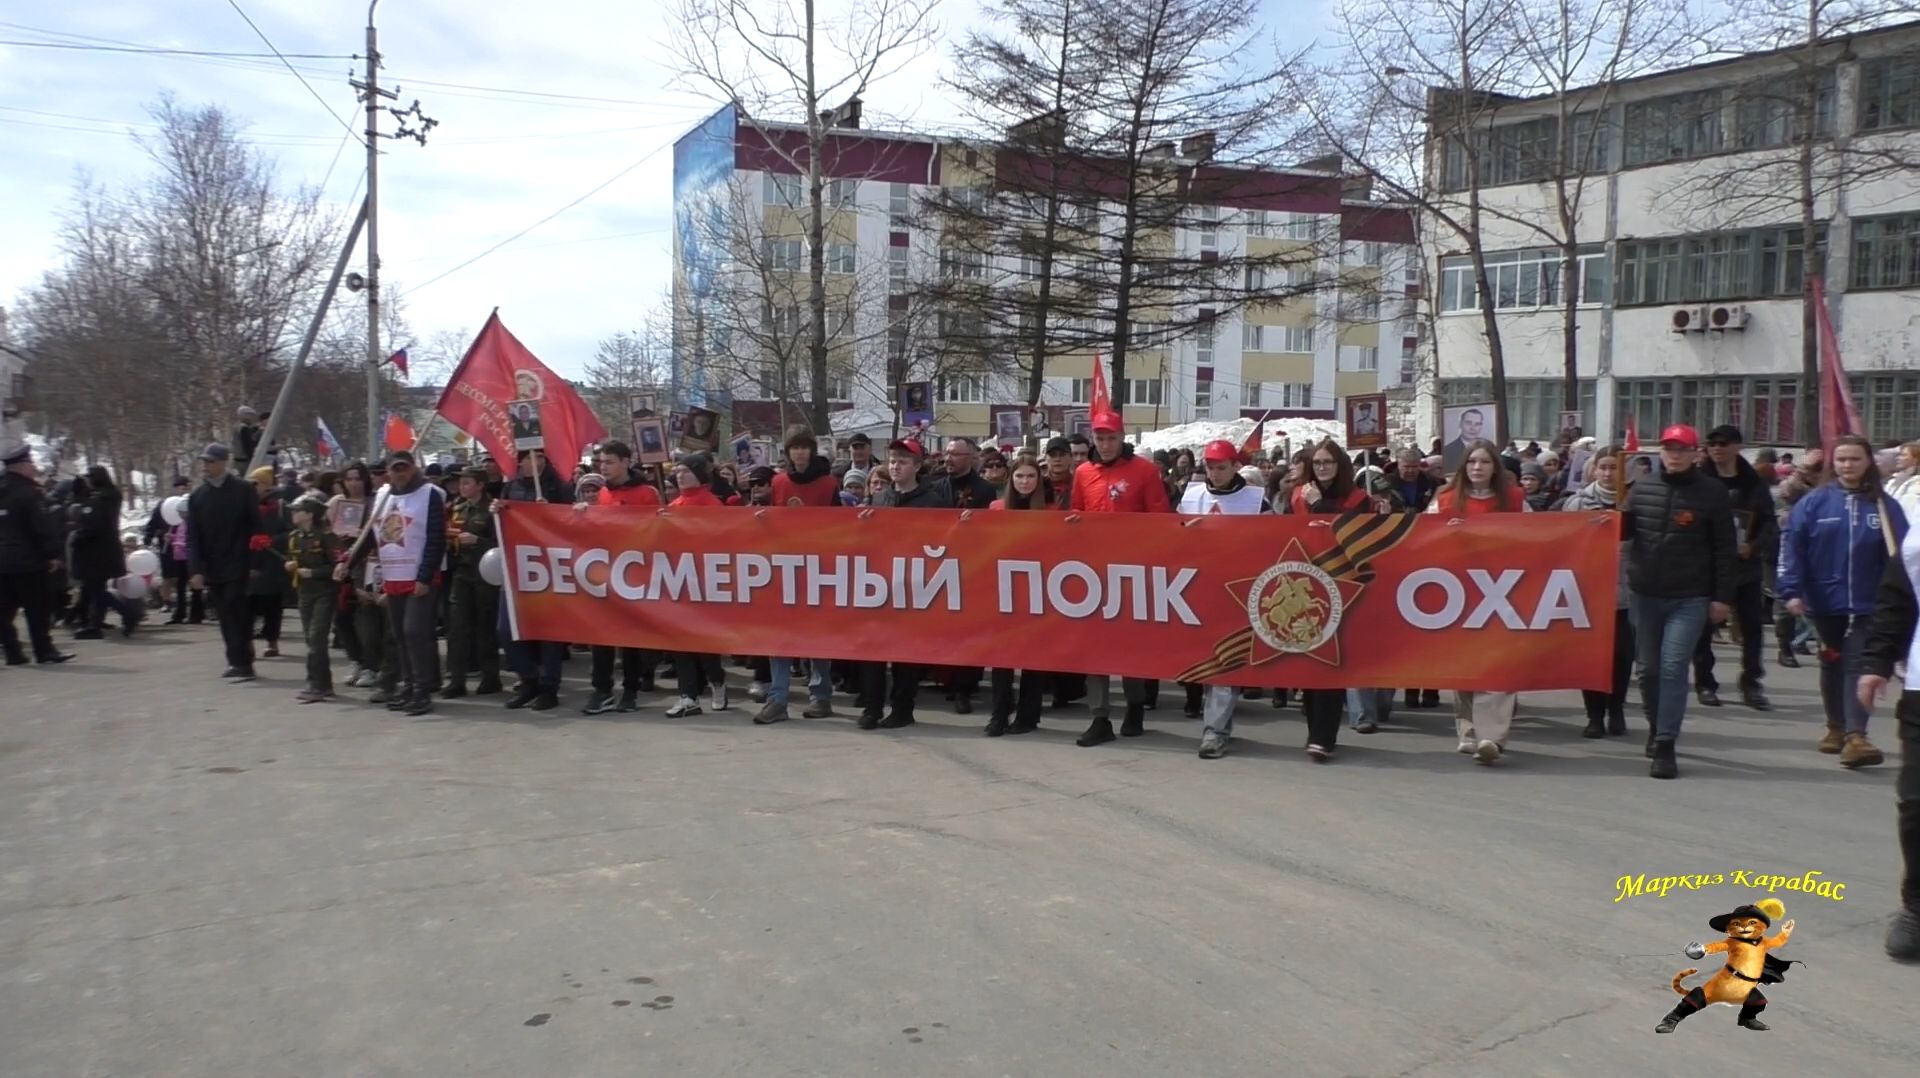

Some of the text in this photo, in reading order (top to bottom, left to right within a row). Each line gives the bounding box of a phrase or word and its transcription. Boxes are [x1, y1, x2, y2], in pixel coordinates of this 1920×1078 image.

[515, 544, 1591, 630] БЕССМЕРТНЫЙ ПОЛК ОХА
